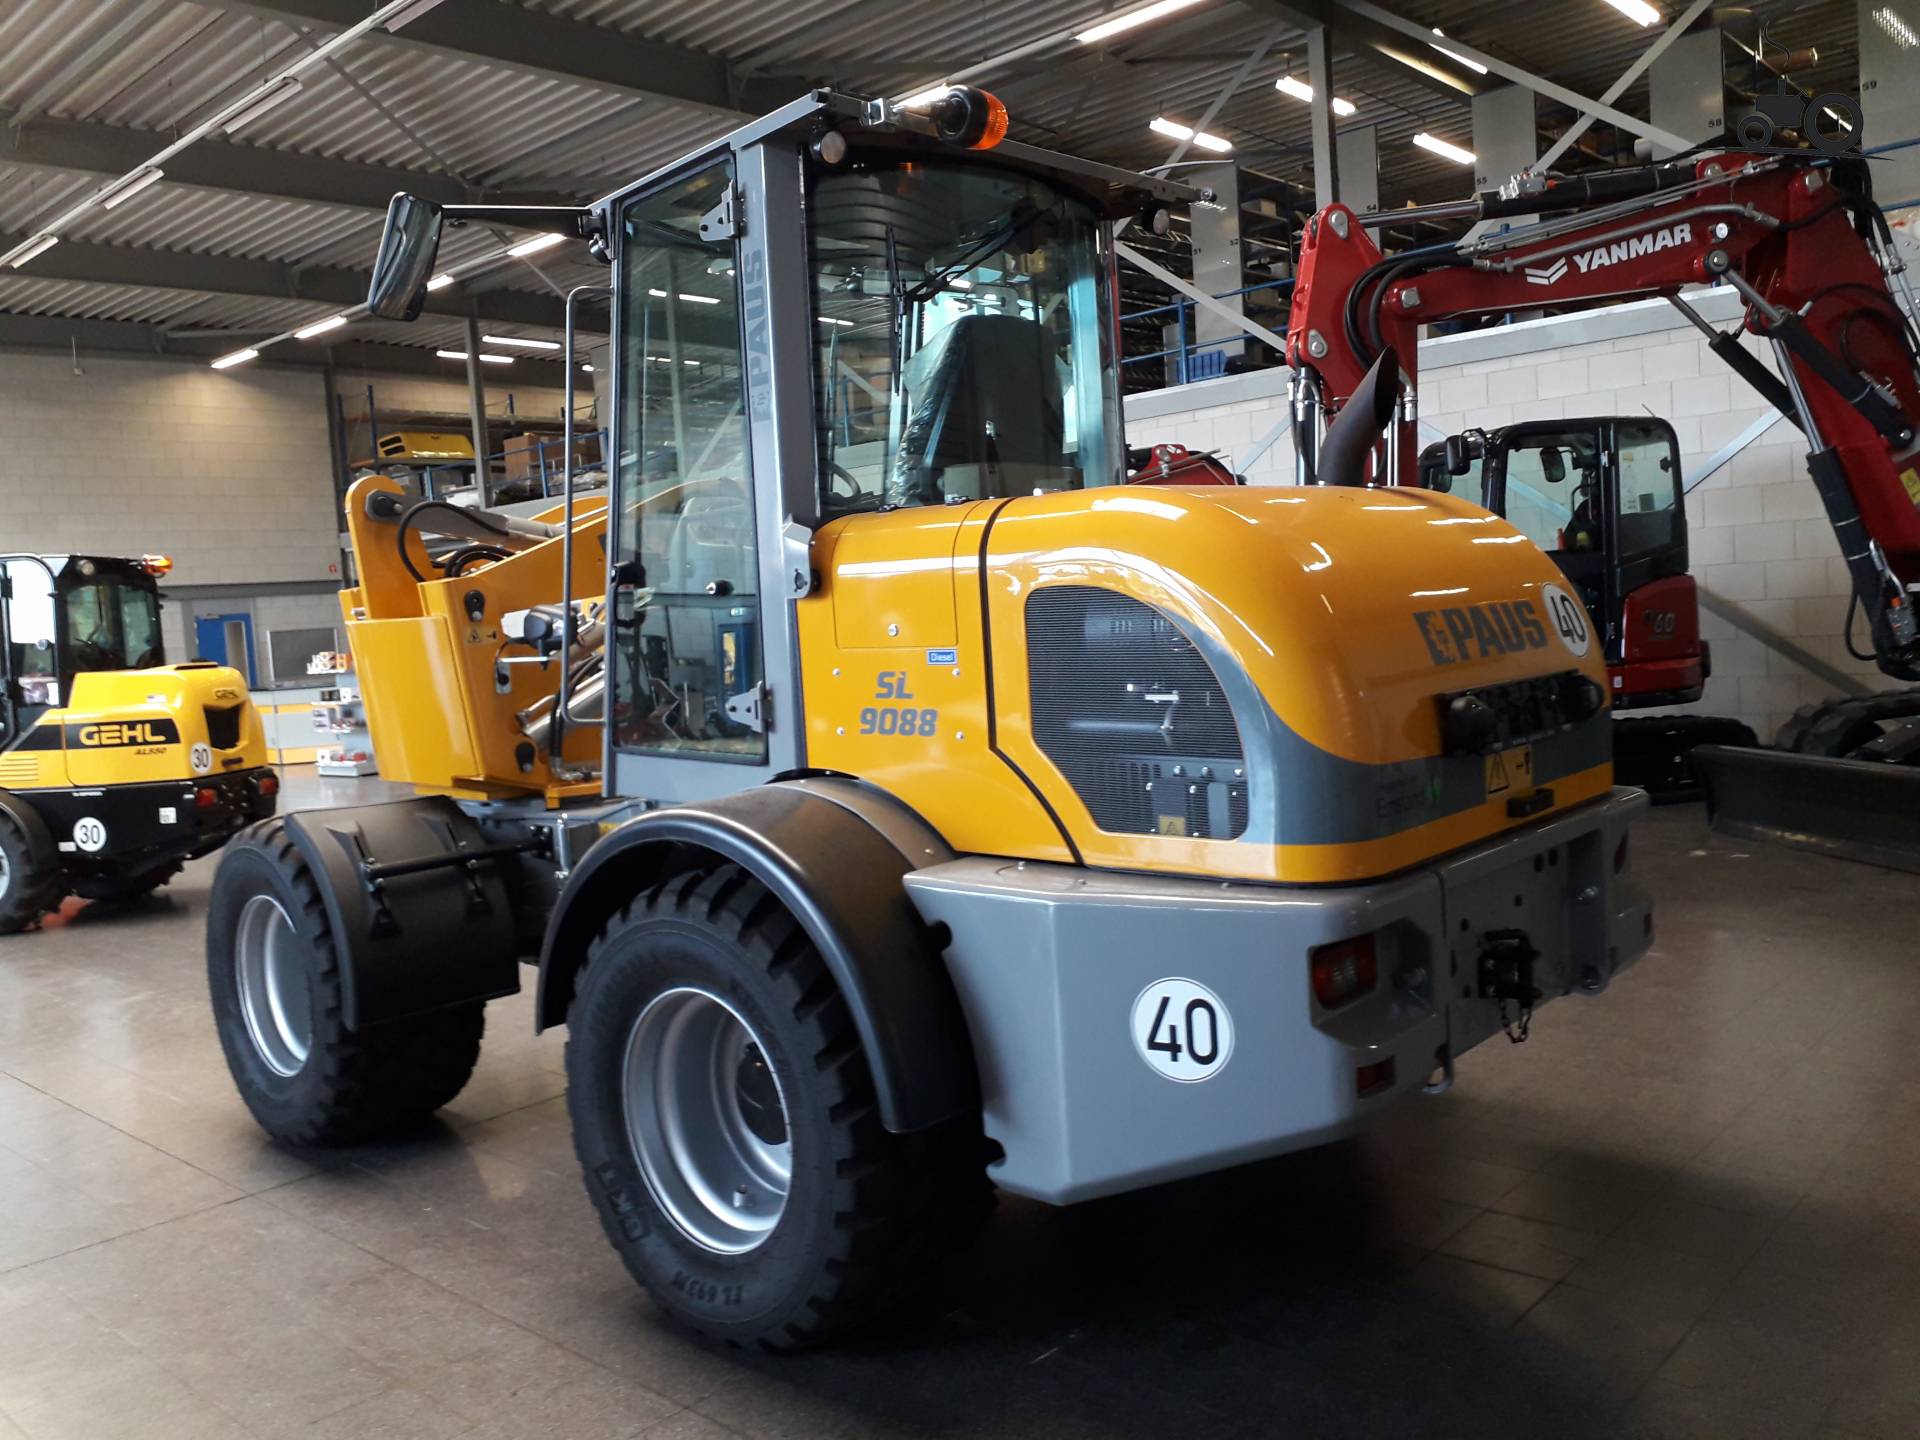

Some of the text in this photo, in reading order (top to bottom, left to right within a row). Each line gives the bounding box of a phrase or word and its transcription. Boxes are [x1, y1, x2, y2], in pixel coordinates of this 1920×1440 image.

[1572, 222, 1692, 273] YANMAR
[1550, 594, 1587, 644] 40
[929, 652, 954, 662] Diesel
[79, 723, 166, 746] GEHL
[859, 707, 938, 737] 9088
[191, 748, 209, 768] 30
[79, 824, 101, 845] 30
[1147, 996, 1218, 1066] 40
